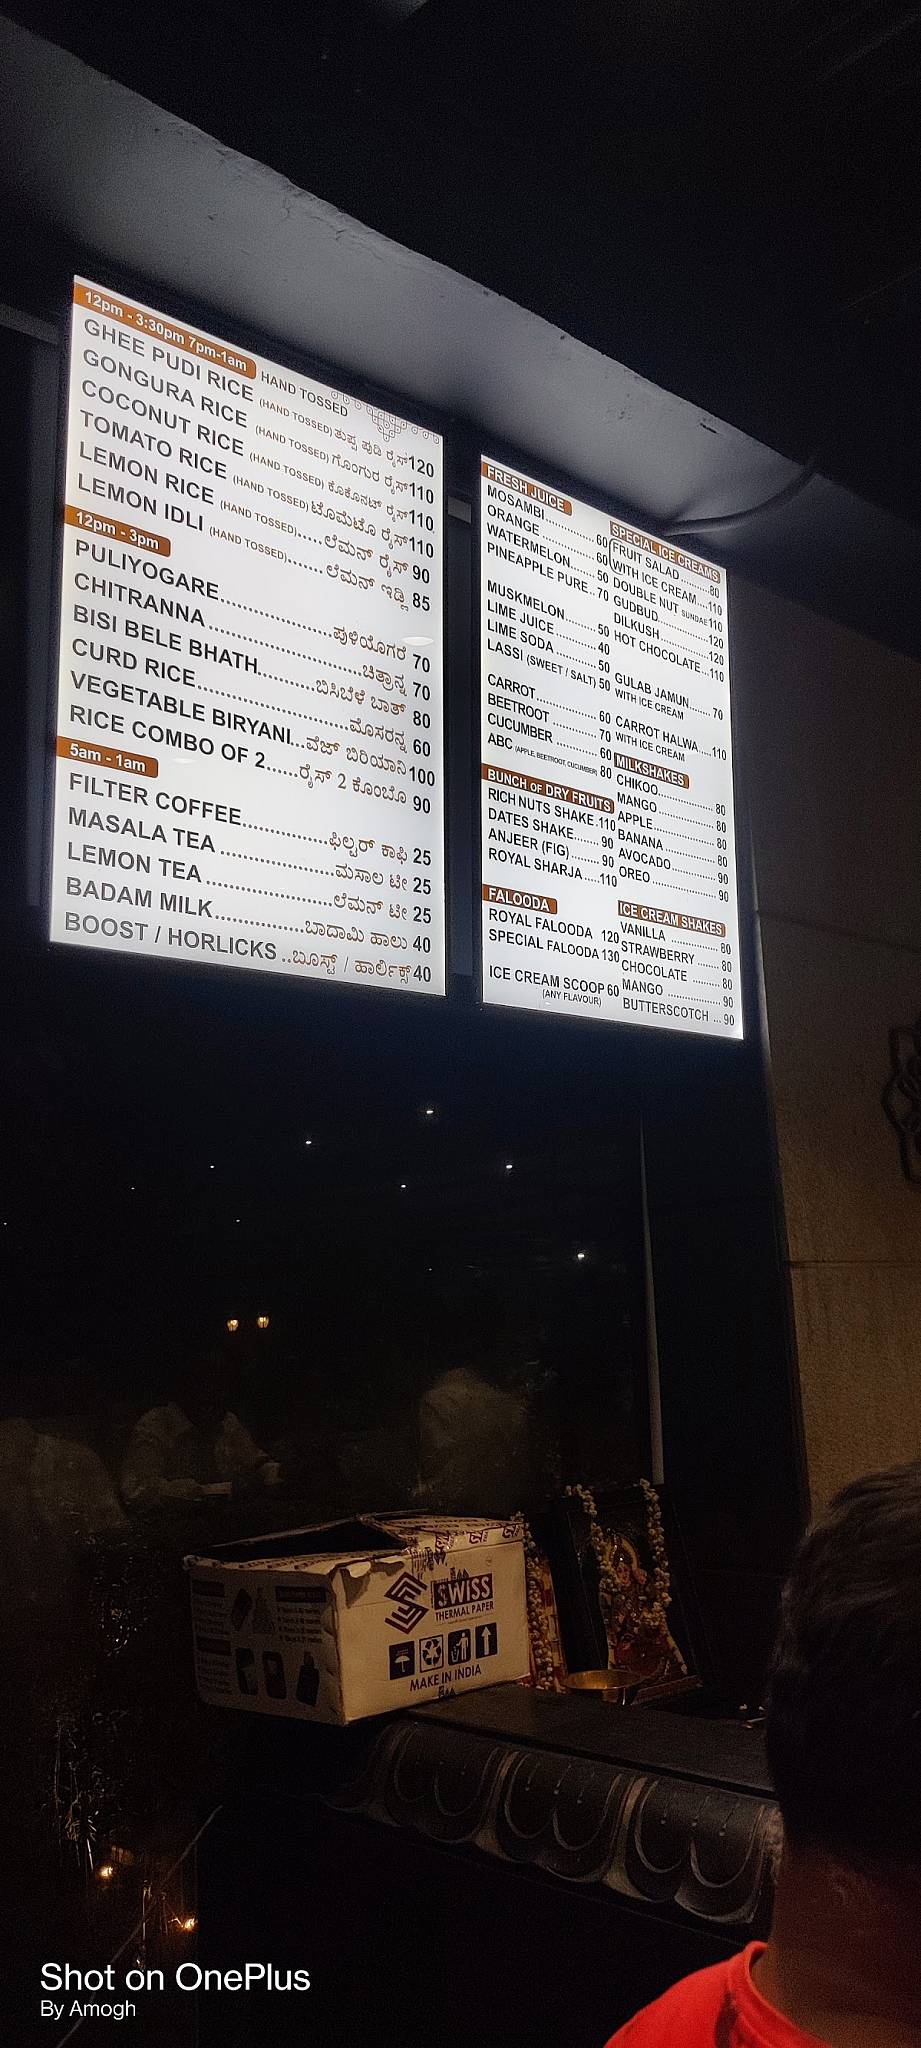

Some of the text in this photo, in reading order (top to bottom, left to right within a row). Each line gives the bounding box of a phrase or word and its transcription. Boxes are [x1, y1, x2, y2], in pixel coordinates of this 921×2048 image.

[84, 290, 247, 374] 12pm 3:30pm 7pm-1am
[83, 349, 247, 428] GONGURA RICE
[84, 318, 434, 478] GHEE PUDI RICE (HAND TOSSED) 120
[261, 370, 348, 417] HAND TOSSED
[82, 380, 244, 457] COCONUT RICE
[80, 441, 214, 505] LEMON RICE
[80, 409, 434, 559] TOMATO RICE 110
[487, 465, 565, 512] FRESH JUICE
[78, 473, 203, 532] LEMON IDLI
[487, 484, 608, 548] MOSAMBI 60
[487, 504, 540, 537] ORANGE
[76, 510, 159, 553] 12pm 3pm
[486, 522, 570, 568] WATERMELON
[76, 539, 219, 601] PULIYOGARE
[487, 541, 589, 594] PINEAPPLE PURE
[611, 523, 719, 583] SPECIAL ICE CREAMS
[612, 541, 680, 580] FRUIT SALAD
[74, 573, 205, 627] CHITRANNA
[487, 579, 565, 620] MUSKMELON
[613, 558, 697, 605] WITH ICE CREAM
[487, 599, 554, 635] LIME JUICE
[613, 576, 723, 633] DOUBLE NUT SUNDAE 110
[613, 595, 659, 622] GUDBUD
[74, 604, 258, 674] BISI BELE BHATH
[487, 618, 554, 654] LIME SODA
[614, 612, 660, 640] DILKUSH
[72, 638, 196, 688] CURD RICE
[412, 653, 430, 673] 70
[487, 638, 611, 692] LASSI (SWEET SALT) 50
[614, 630, 701, 674] HOT CHOCOLATE
[487, 673, 536, 699] CARROT
[614, 672, 689, 709] GULAB JAMUN
[71, 670, 291, 745] VEGETABLE BIRYANI
[488, 692, 550, 723] BEETROOT
[70, 704, 265, 769] RICE COMBO OF 2
[487, 712, 553, 744] CUCUMBER
[487, 732, 513, 750] ABC
[615, 715, 699, 753] CARROT HALWA
[69, 742, 146, 774] 5am 1am
[413, 738, 431, 757] 60
[616, 754, 685, 787] MILKSHAKES
[616, 773, 658, 796] CHIKOO
[488, 768, 611, 813] BUNCH DRY FRUITS
[488, 787, 594, 826] RICH NUTS SHAKE
[69, 806, 216, 853] MASALA TEA
[70, 772, 432, 866] FILTER COFFEE 25
[488, 807, 574, 840] DATES SHAKE
[617, 791, 727, 834] MANGO 80
[617, 810, 653, 830] APPLE
[488, 828, 614, 868] ANJEER (FIG) 90
[618, 828, 664, 851] BANANA
[68, 841, 202, 883] LEMON TEA
[488, 847, 583, 880] ROYAL SHARJA
[618, 847, 671, 870] AVOCADO
[618, 866, 651, 883] OREO
[66, 876, 212, 918] BADAM MILK
[488, 888, 550, 912] FALOODA
[65, 911, 277, 960] BOOST HORLICKS
[489, 908, 593, 940] ROYAL FALOODA
[620, 902, 723, 936] ICE CREAM SHAKES
[620, 921, 666, 942] VANILLA
[412, 935, 431, 954] 40
[488, 928, 600, 960] SPECIAL FALOODA
[621, 940, 695, 965] STRAWBERRY
[490, 965, 605, 995] ICE CREAM SCOOP
[621, 959, 733, 991] CHOCOLATE 80
[622, 978, 664, 996] MANGO
[542, 989, 602, 1006] (ANY FLAVOUR)
[623, 997, 709, 1022] BUTTERSCOTCH
[437, 1575, 491, 1608] SWISS
[435, 1601, 494, 1621] THERMAL PAPER
[410, 1664, 482, 1691] MAKE IN INDIA
